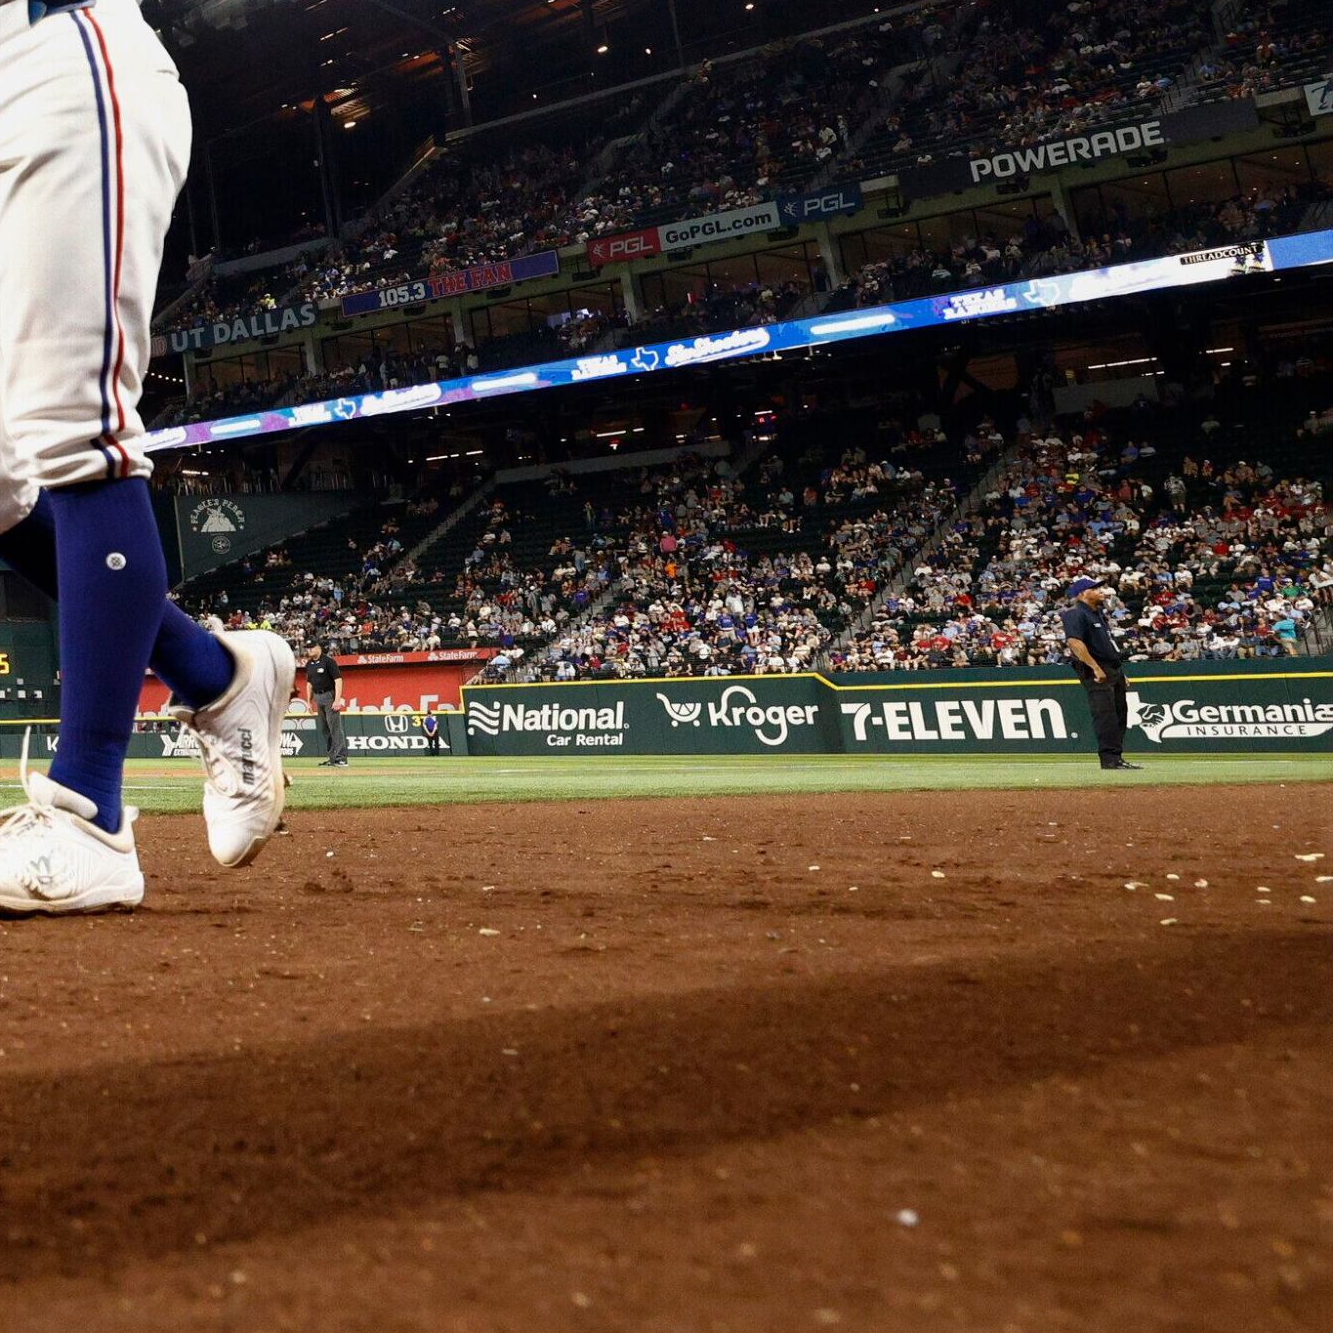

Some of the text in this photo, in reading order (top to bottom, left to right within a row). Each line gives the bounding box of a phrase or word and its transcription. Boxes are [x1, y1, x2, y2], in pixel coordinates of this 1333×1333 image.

[970, 120, 1166, 183] POWERADE
[804, 193, 856, 216] PGL
[665, 209, 772, 244] GoPGL.com
[609, 234, 654, 258] PGL
[378, 263, 512, 309] 105.3 THE FAN
[170, 303, 316, 353] UT DALLAS
[502, 701, 624, 732] National
[708, 685, 820, 746] Kroger
[1186, 725, 1308, 738] INSURANCE
[546, 733, 624, 746] Car Rental
